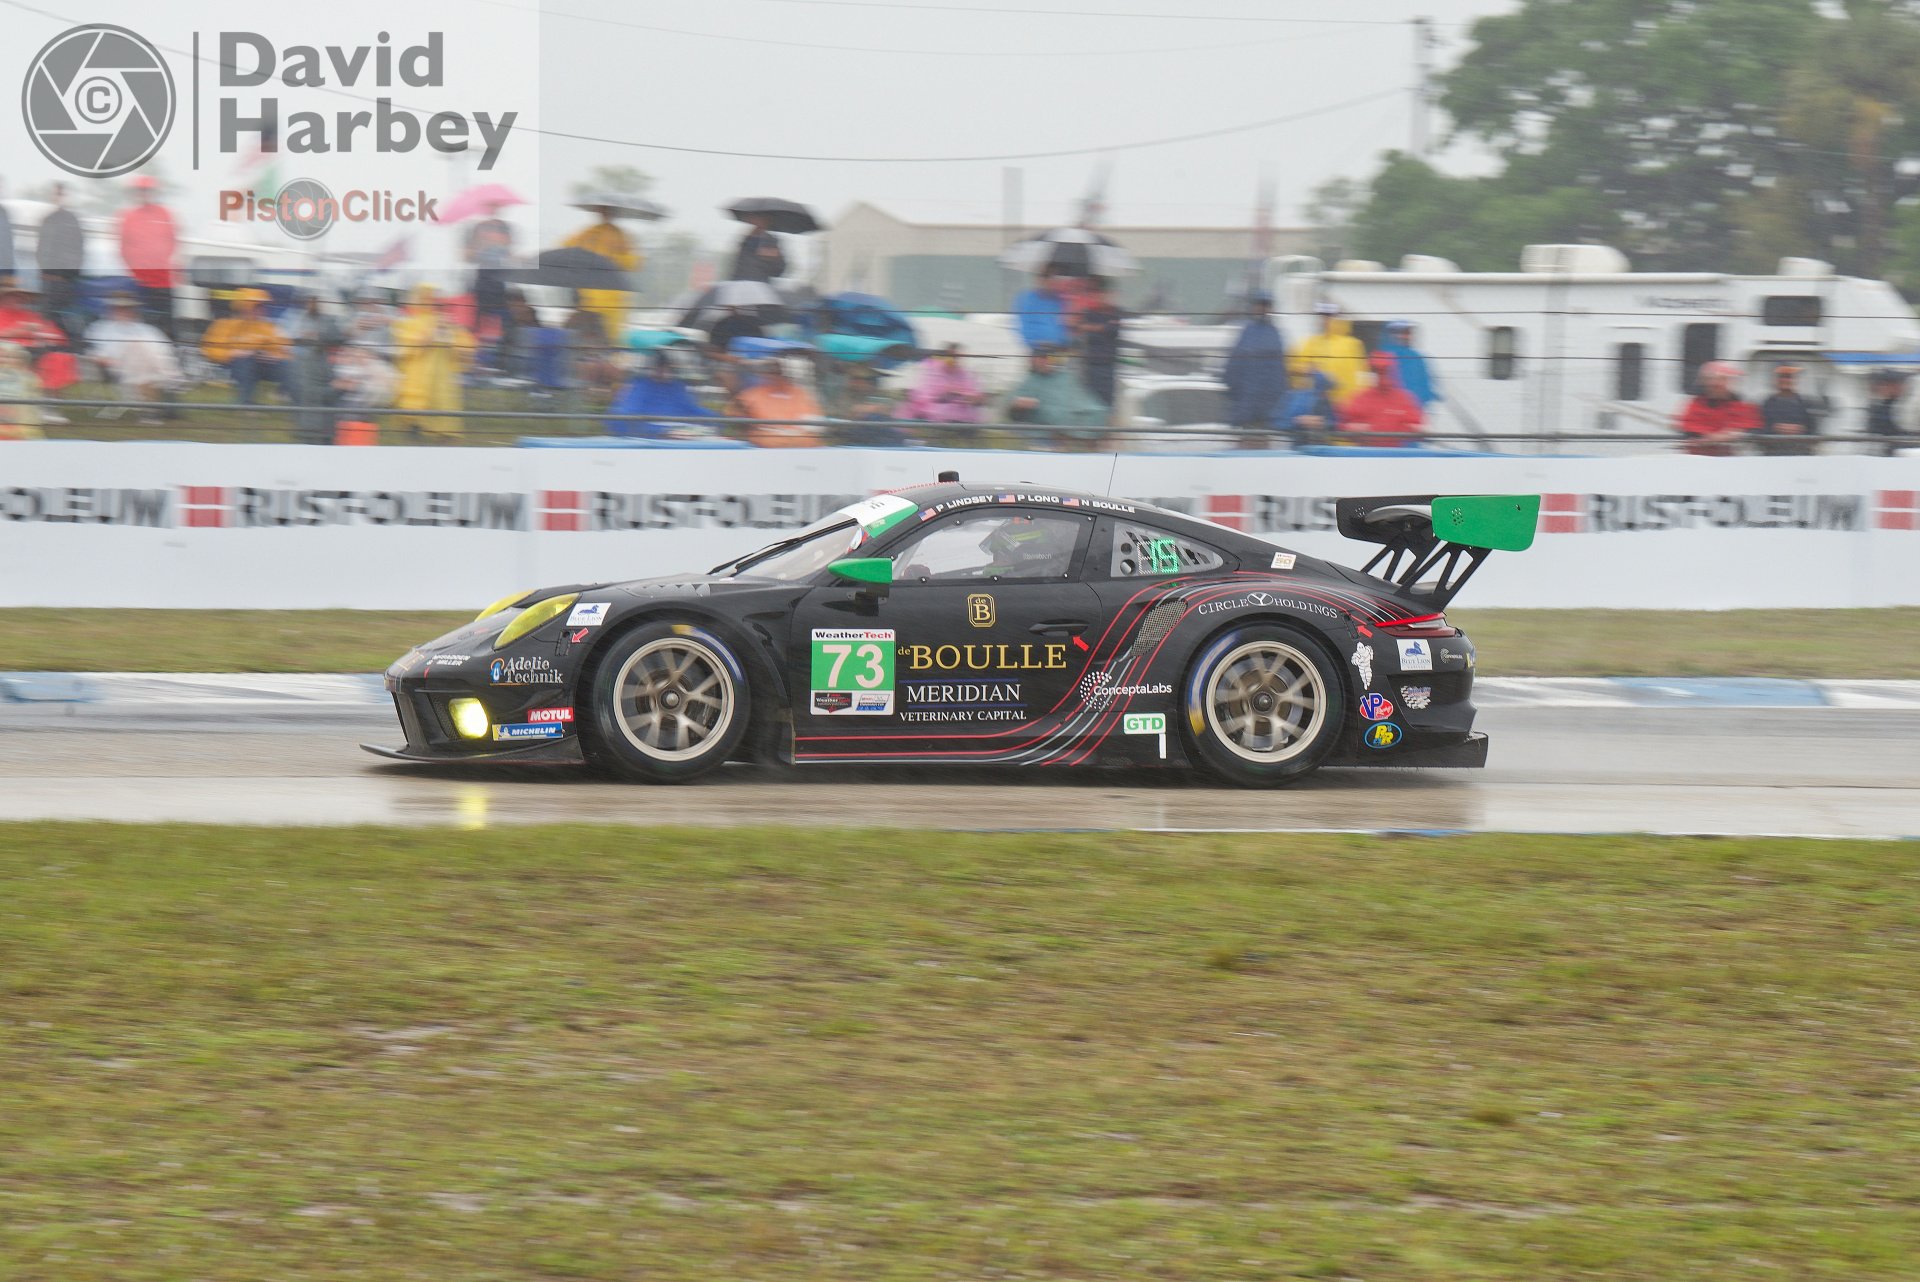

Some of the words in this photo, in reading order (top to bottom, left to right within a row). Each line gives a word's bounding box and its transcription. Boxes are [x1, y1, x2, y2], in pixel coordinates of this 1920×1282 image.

[936, 504, 944, 512] P
[947, 495, 993, 509] LINDSEY
[1017, 494, 1025, 502] P
[1027, 495, 1059, 503] LONG
[1092, 500, 1135, 513] BOULLE
[973, 603, 991, 621] B
[1198, 598, 1249, 615] CIRCLE
[1274, 598, 1338, 619] HOLDINGS
[815, 631, 893, 639] WeatherTech
[506, 656, 550, 672] Adelie
[909, 644, 1067, 670] BOULLE
[822, 643, 885, 689] 73
[503, 667, 563, 685] Technik
[906, 684, 1021, 703] MERIDIAN
[1093, 682, 1172, 697] ConceptaLabs
[1360, 692, 1384, 720] VP
[529, 709, 572, 721] MOTUL
[900, 711, 974, 722] VETERINARY
[977, 710, 1027, 721] CAPITAL
[511, 726, 556, 737] MICHELIN
[1126, 717, 1164, 731] GTD
